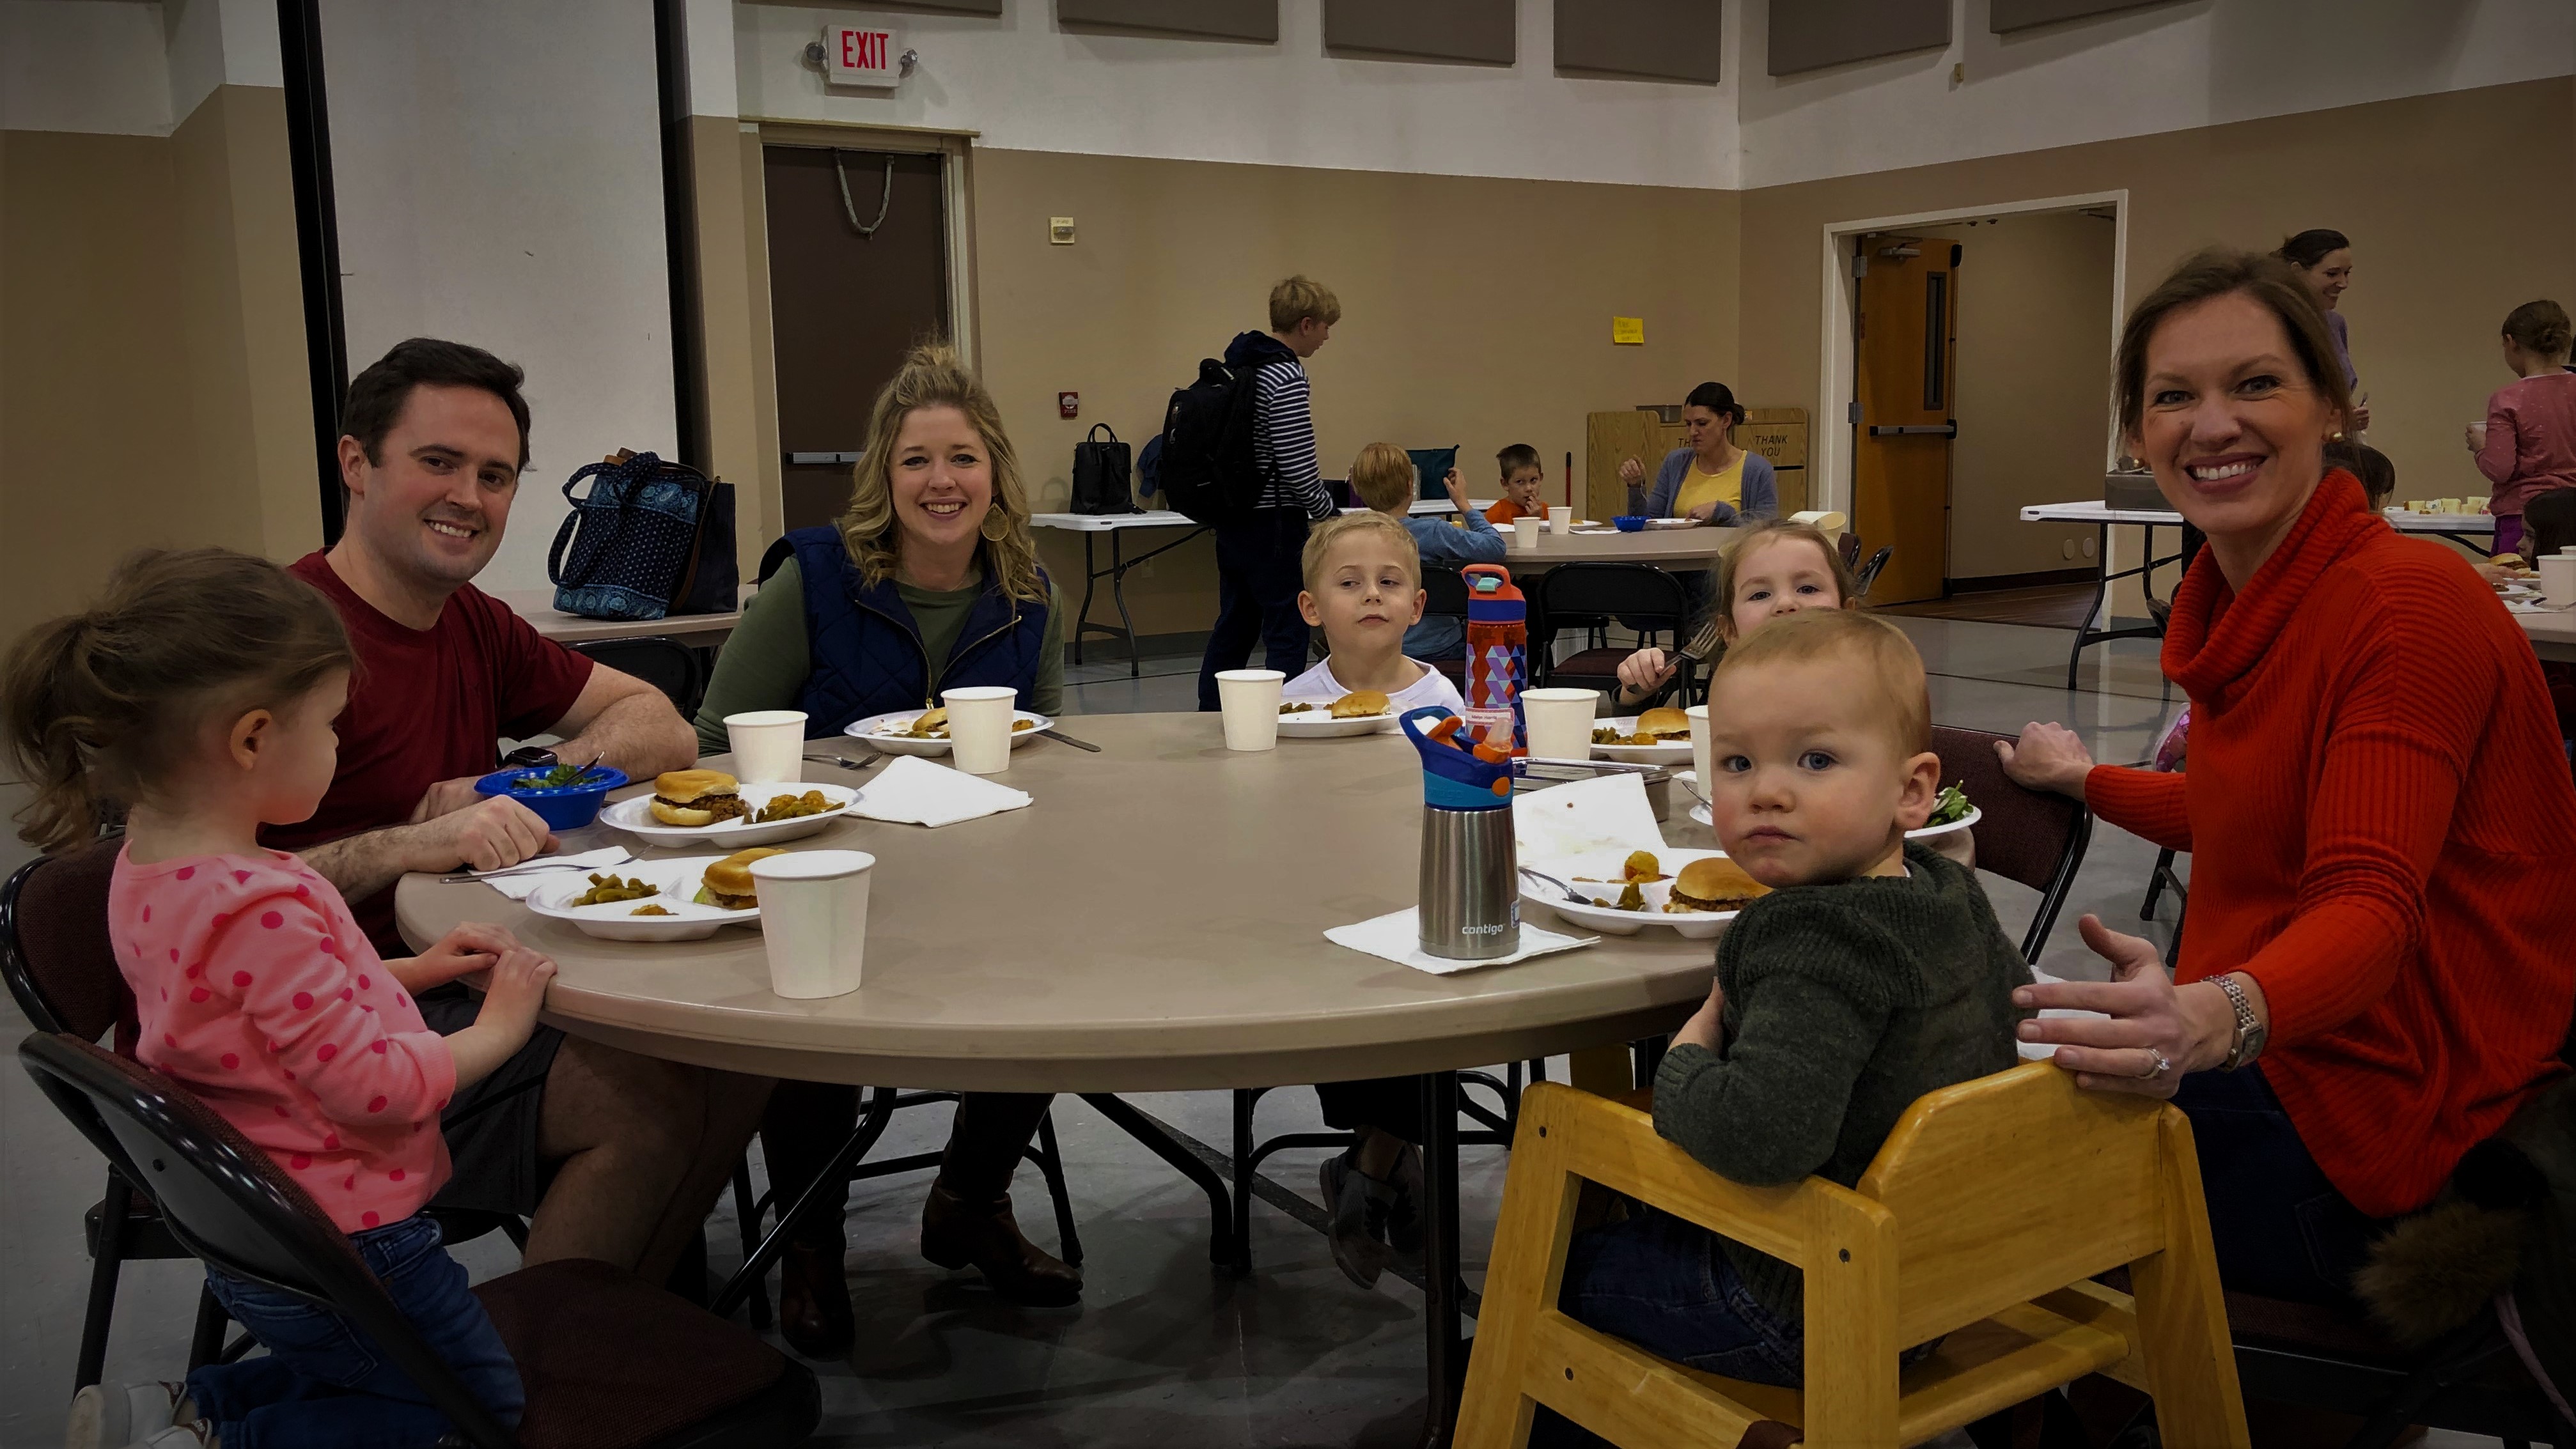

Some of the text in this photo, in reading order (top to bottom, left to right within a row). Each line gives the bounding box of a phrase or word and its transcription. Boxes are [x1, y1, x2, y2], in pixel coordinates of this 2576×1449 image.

[841, 30, 888, 70] EXIT
[1755, 435, 1788, 445] THANK
[1761, 447, 1781, 456] YOU
[1462, 923, 1504, 936] contigo
